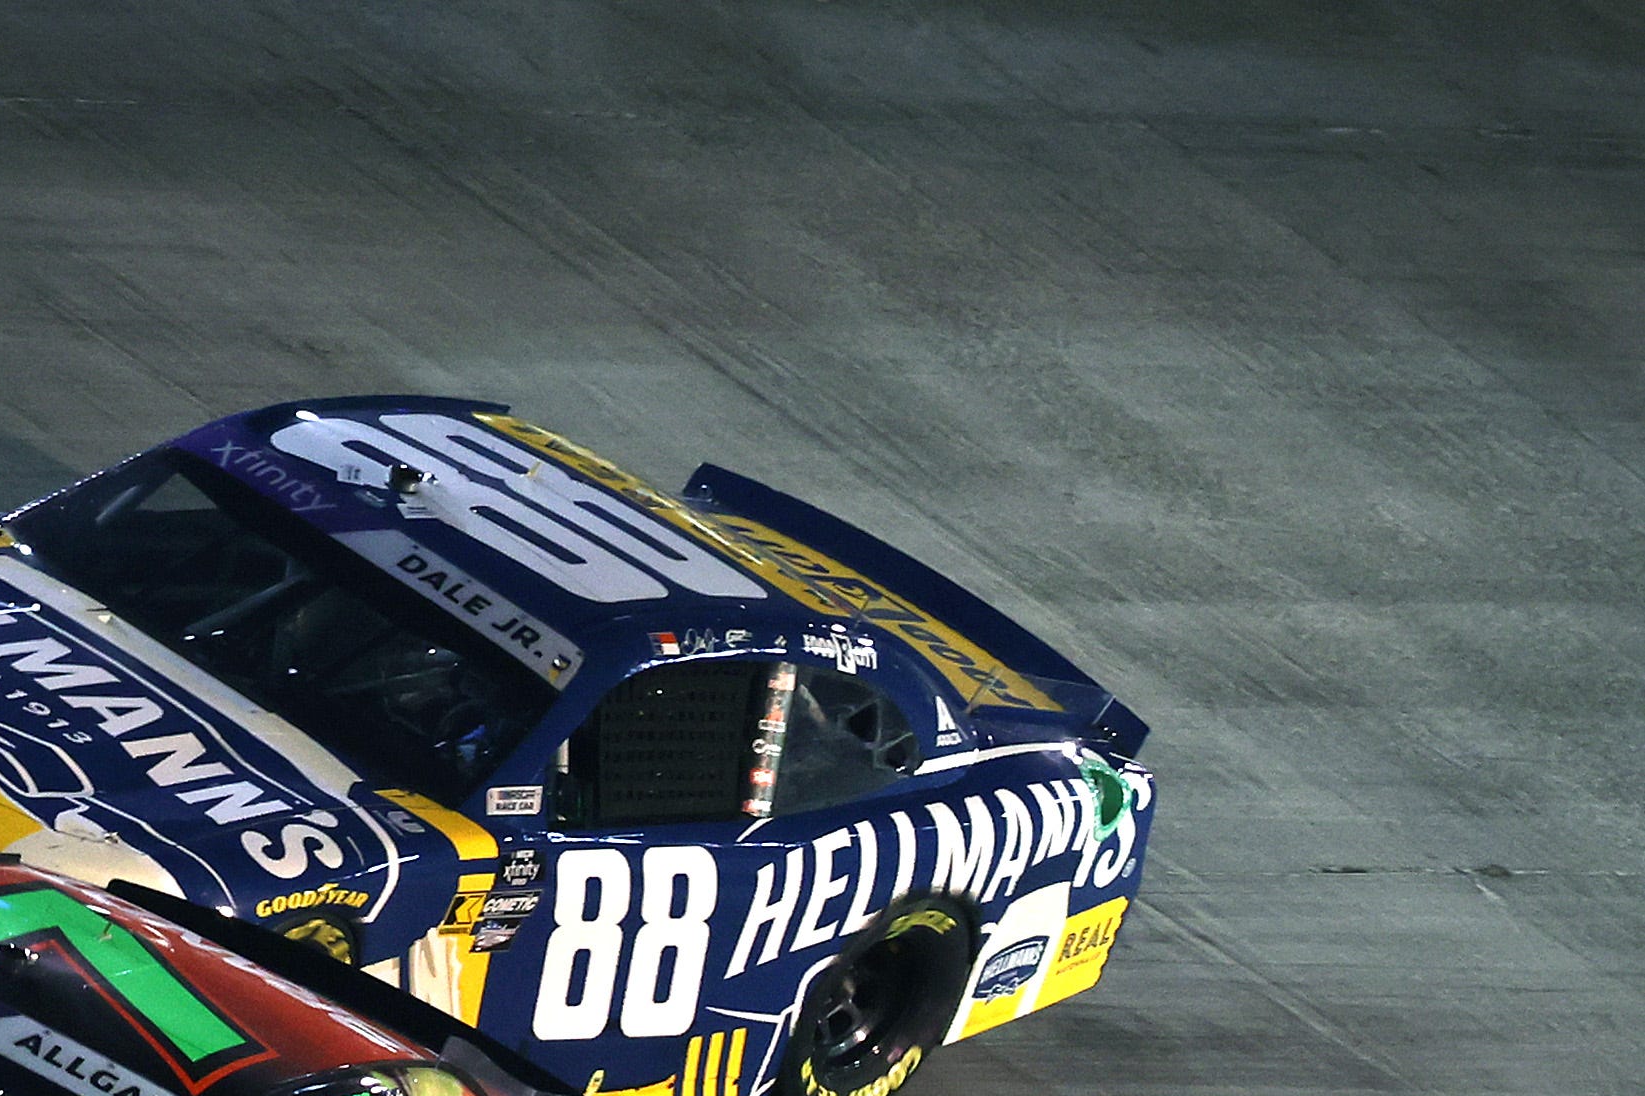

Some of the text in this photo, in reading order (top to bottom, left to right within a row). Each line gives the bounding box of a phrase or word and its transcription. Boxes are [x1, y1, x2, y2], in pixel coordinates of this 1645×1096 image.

[210, 440, 338, 512] xfinity
[396, 553, 543, 658] DALE JR.
[256, 882, 369, 917] GOODYEAR
[533, 845, 718, 1041] 88
[1058, 917, 1113, 963] REAL
